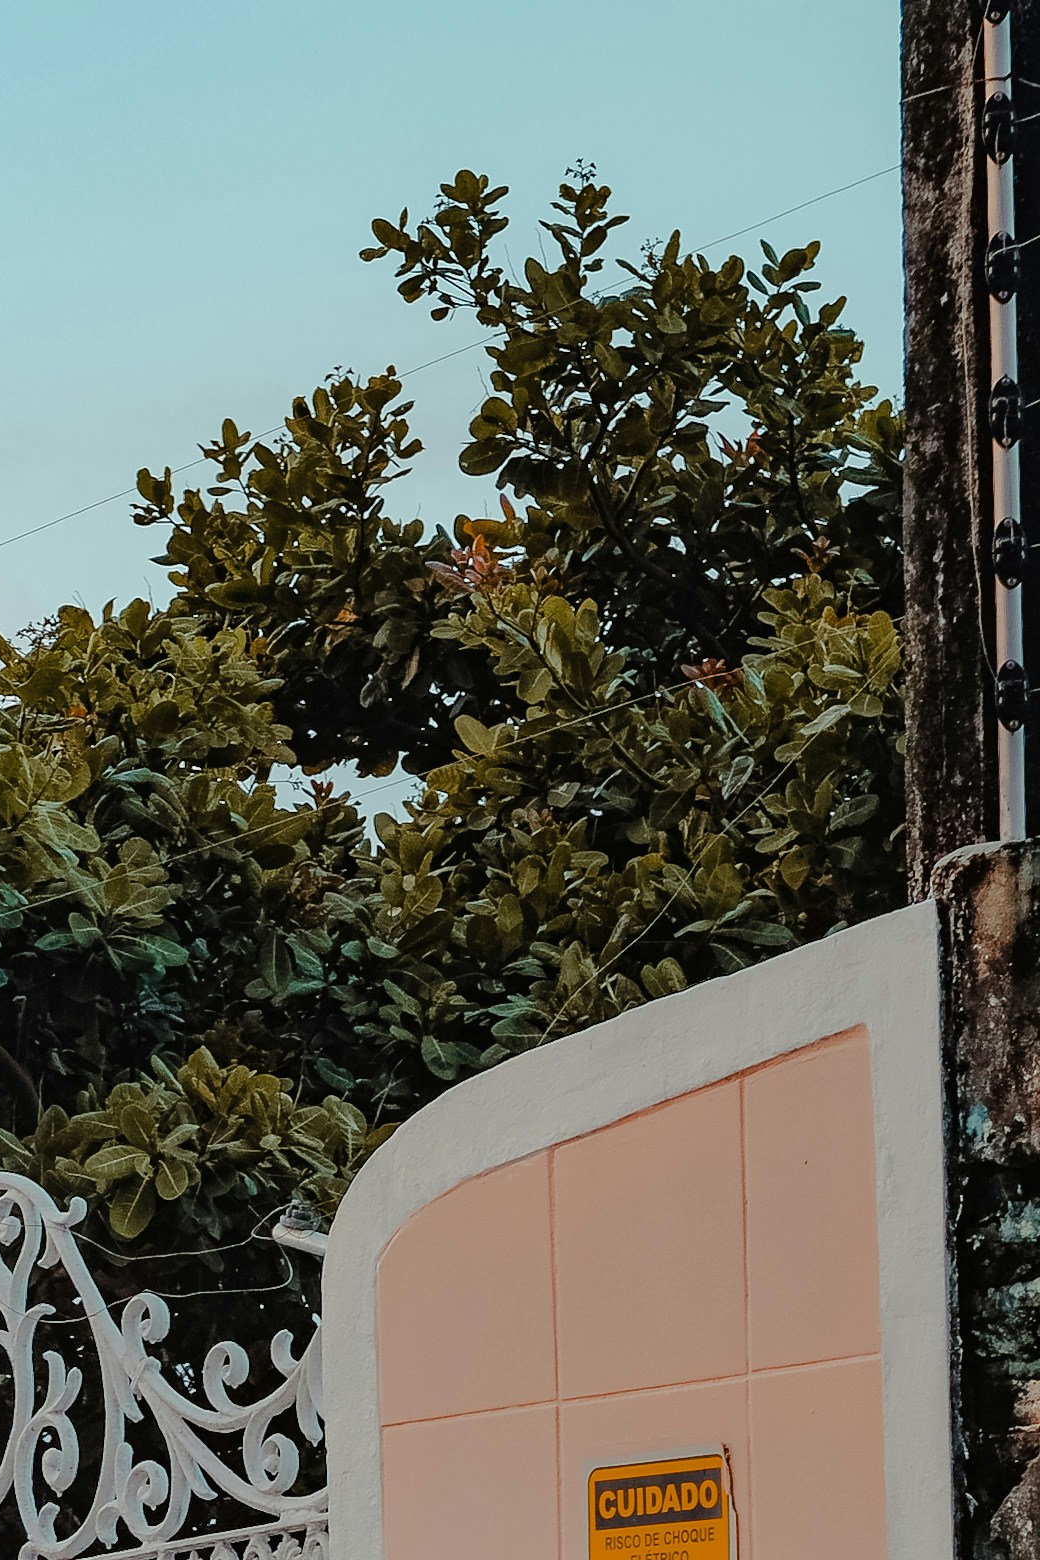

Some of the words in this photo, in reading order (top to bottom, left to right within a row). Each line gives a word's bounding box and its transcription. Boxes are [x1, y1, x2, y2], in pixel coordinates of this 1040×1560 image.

[598, 1479, 719, 1520] CUIDADO
[605, 1534, 641, 1551] RISCO
[645, 1532, 660, 1547] DE
[664, 1527, 715, 1545] CHOQUE
